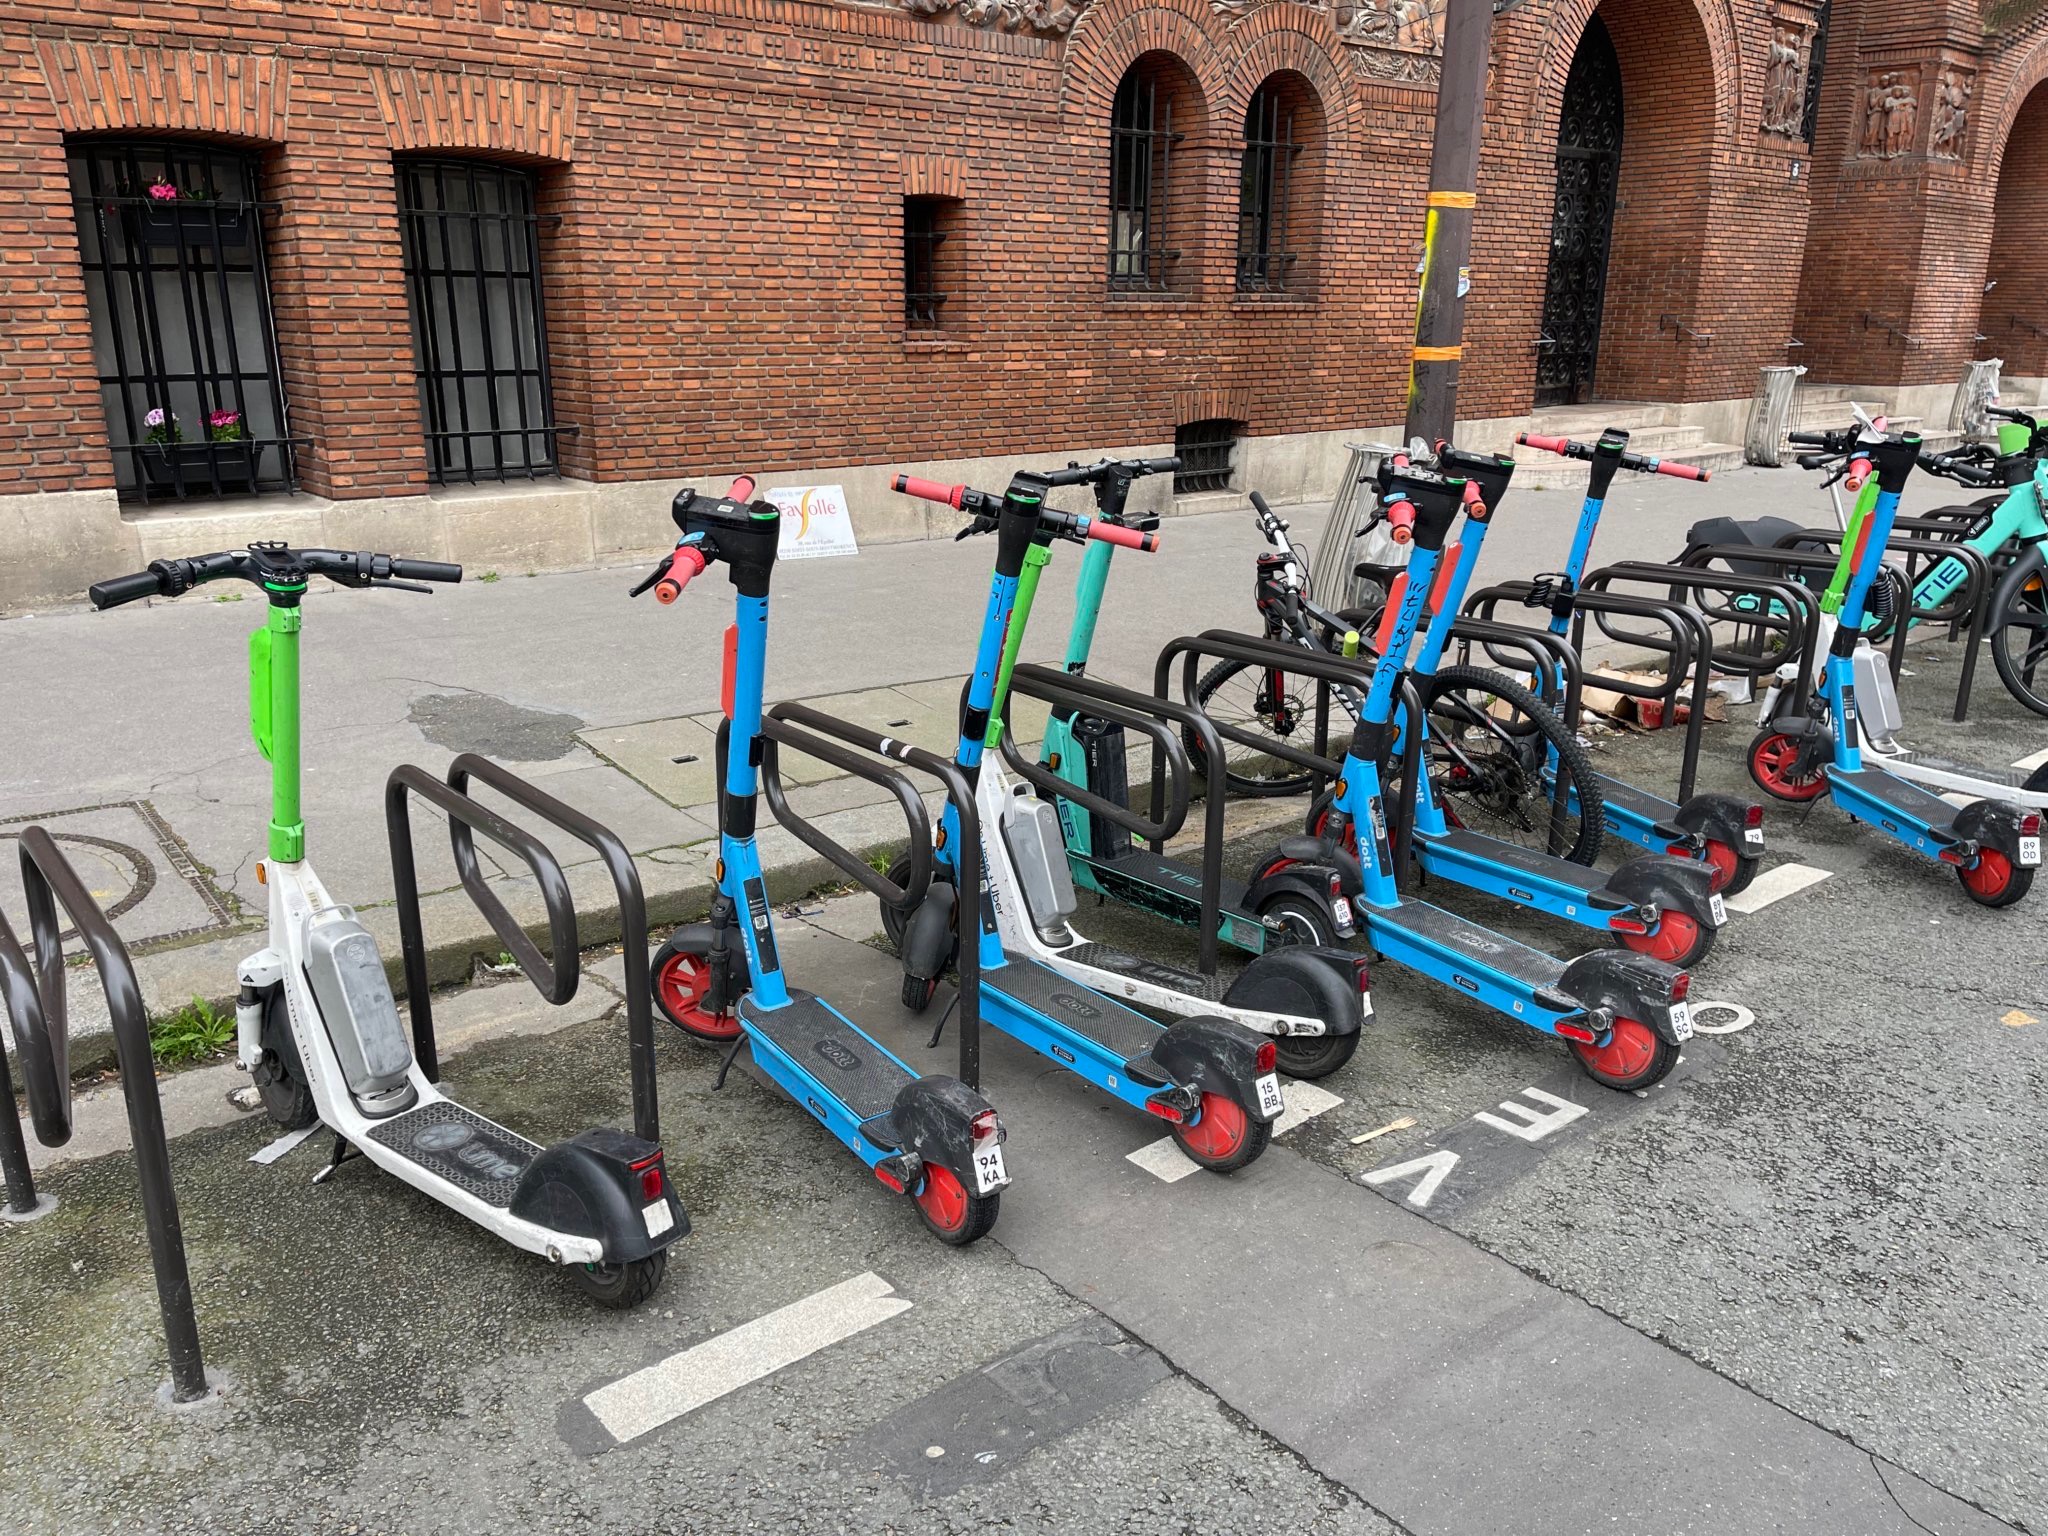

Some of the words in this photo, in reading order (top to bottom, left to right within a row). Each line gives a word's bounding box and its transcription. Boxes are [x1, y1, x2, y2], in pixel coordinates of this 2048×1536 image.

[1914, 562, 1963, 602] TIE
[1059, 798, 1074, 839] IER
[1749, 834, 1760, 842] 79
[2023, 841, 2035, 849] 89
[1360, 836, 1373, 869] dott
[1158, 866, 1202, 888] TIE
[990, 883, 1004, 915] Uber
[741, 928, 753, 965] dott
[1674, 1011, 1685, 1023] 59
[1676, 1023, 1689, 1036] SC
[301, 1044, 317, 1083] Uber
[1261, 1081, 1273, 1095] 15
[1264, 1094, 1278, 1109] BB
[980, 1153, 997, 1170] 94
[983, 1169, 1000, 1185] KA
